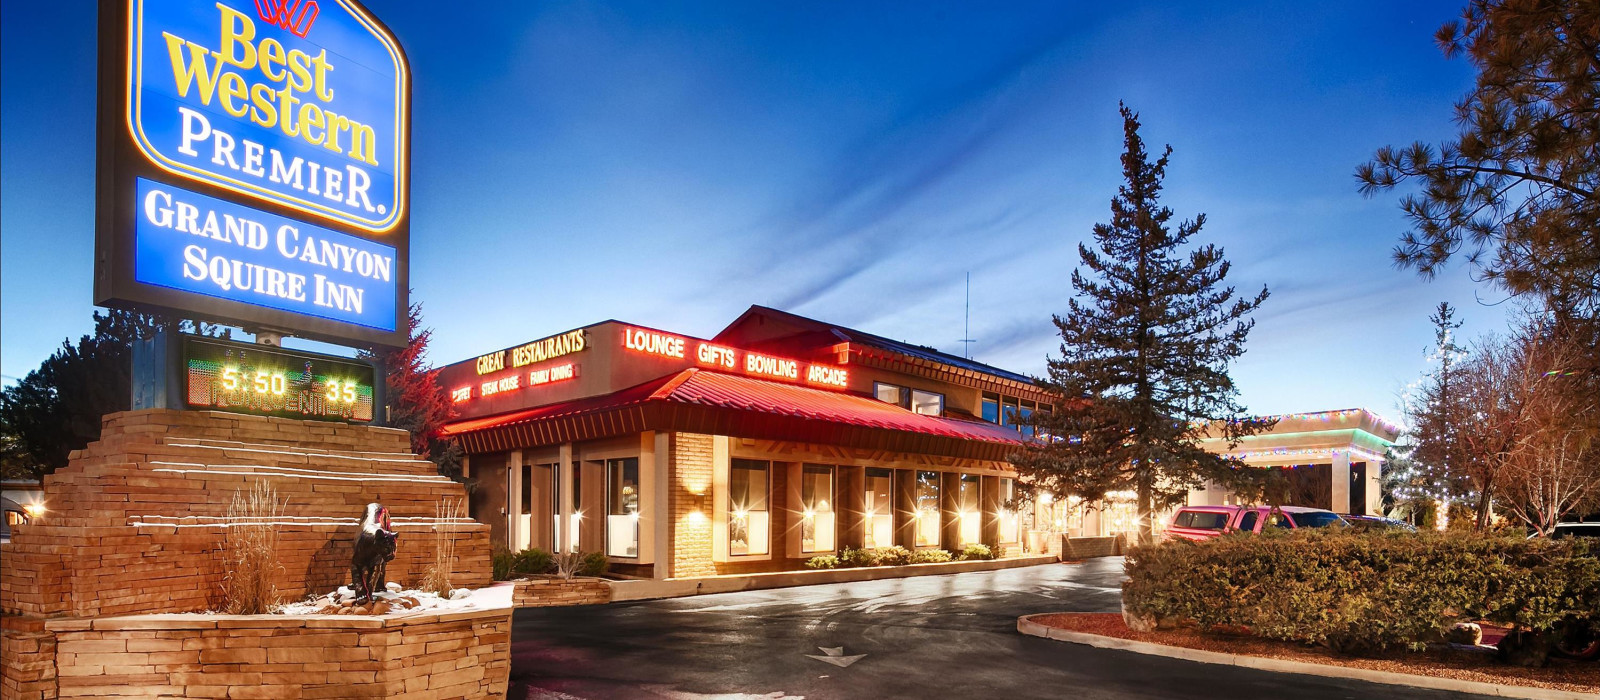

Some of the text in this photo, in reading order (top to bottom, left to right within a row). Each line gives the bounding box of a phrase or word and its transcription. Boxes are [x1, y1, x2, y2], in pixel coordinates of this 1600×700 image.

[216, 2, 334, 102] Best
[162, 31, 379, 166] Western
[178, 106, 376, 214] PREMIER
[144, 189, 392, 282] GRAND CANYON
[183, 244, 364, 314] SQUIRE INN
[222, 367, 286, 396] 5:50
[326, 379, 356, 404] 35
[476, 329, 584, 375] GREAT RESTAURANTS
[481, 380, 499, 396] STEAK
[499, 375, 519, 392] HOUSE
[530, 369, 550, 386] FAMILY
[551, 364, 573, 382] DINING
[626, 328, 847, 387] LOUNGE GIFTS BOWLING ARCADE
